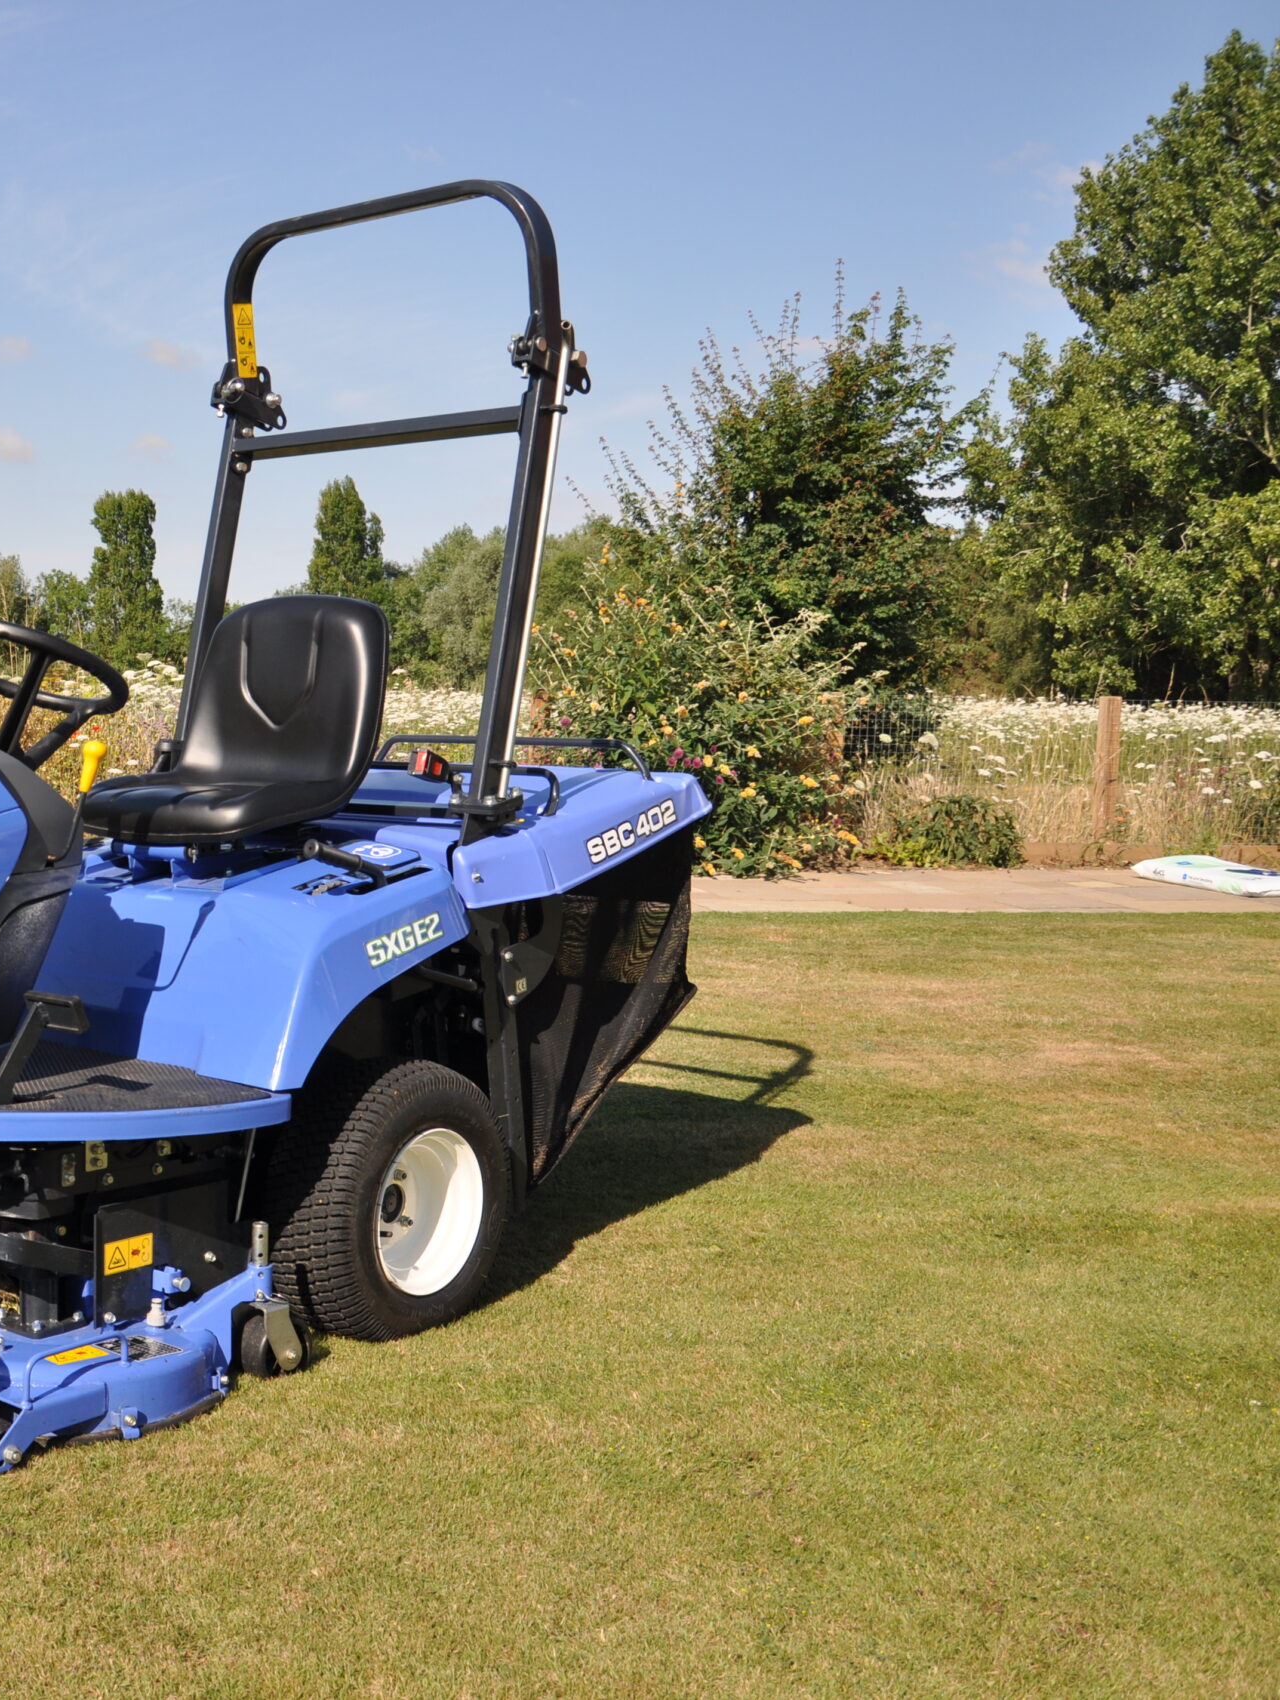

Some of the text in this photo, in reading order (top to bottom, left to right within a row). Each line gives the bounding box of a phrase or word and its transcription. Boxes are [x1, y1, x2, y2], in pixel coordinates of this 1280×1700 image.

[586, 799, 677, 864] SBC 402
[366, 912, 444, 967] SXGE2
